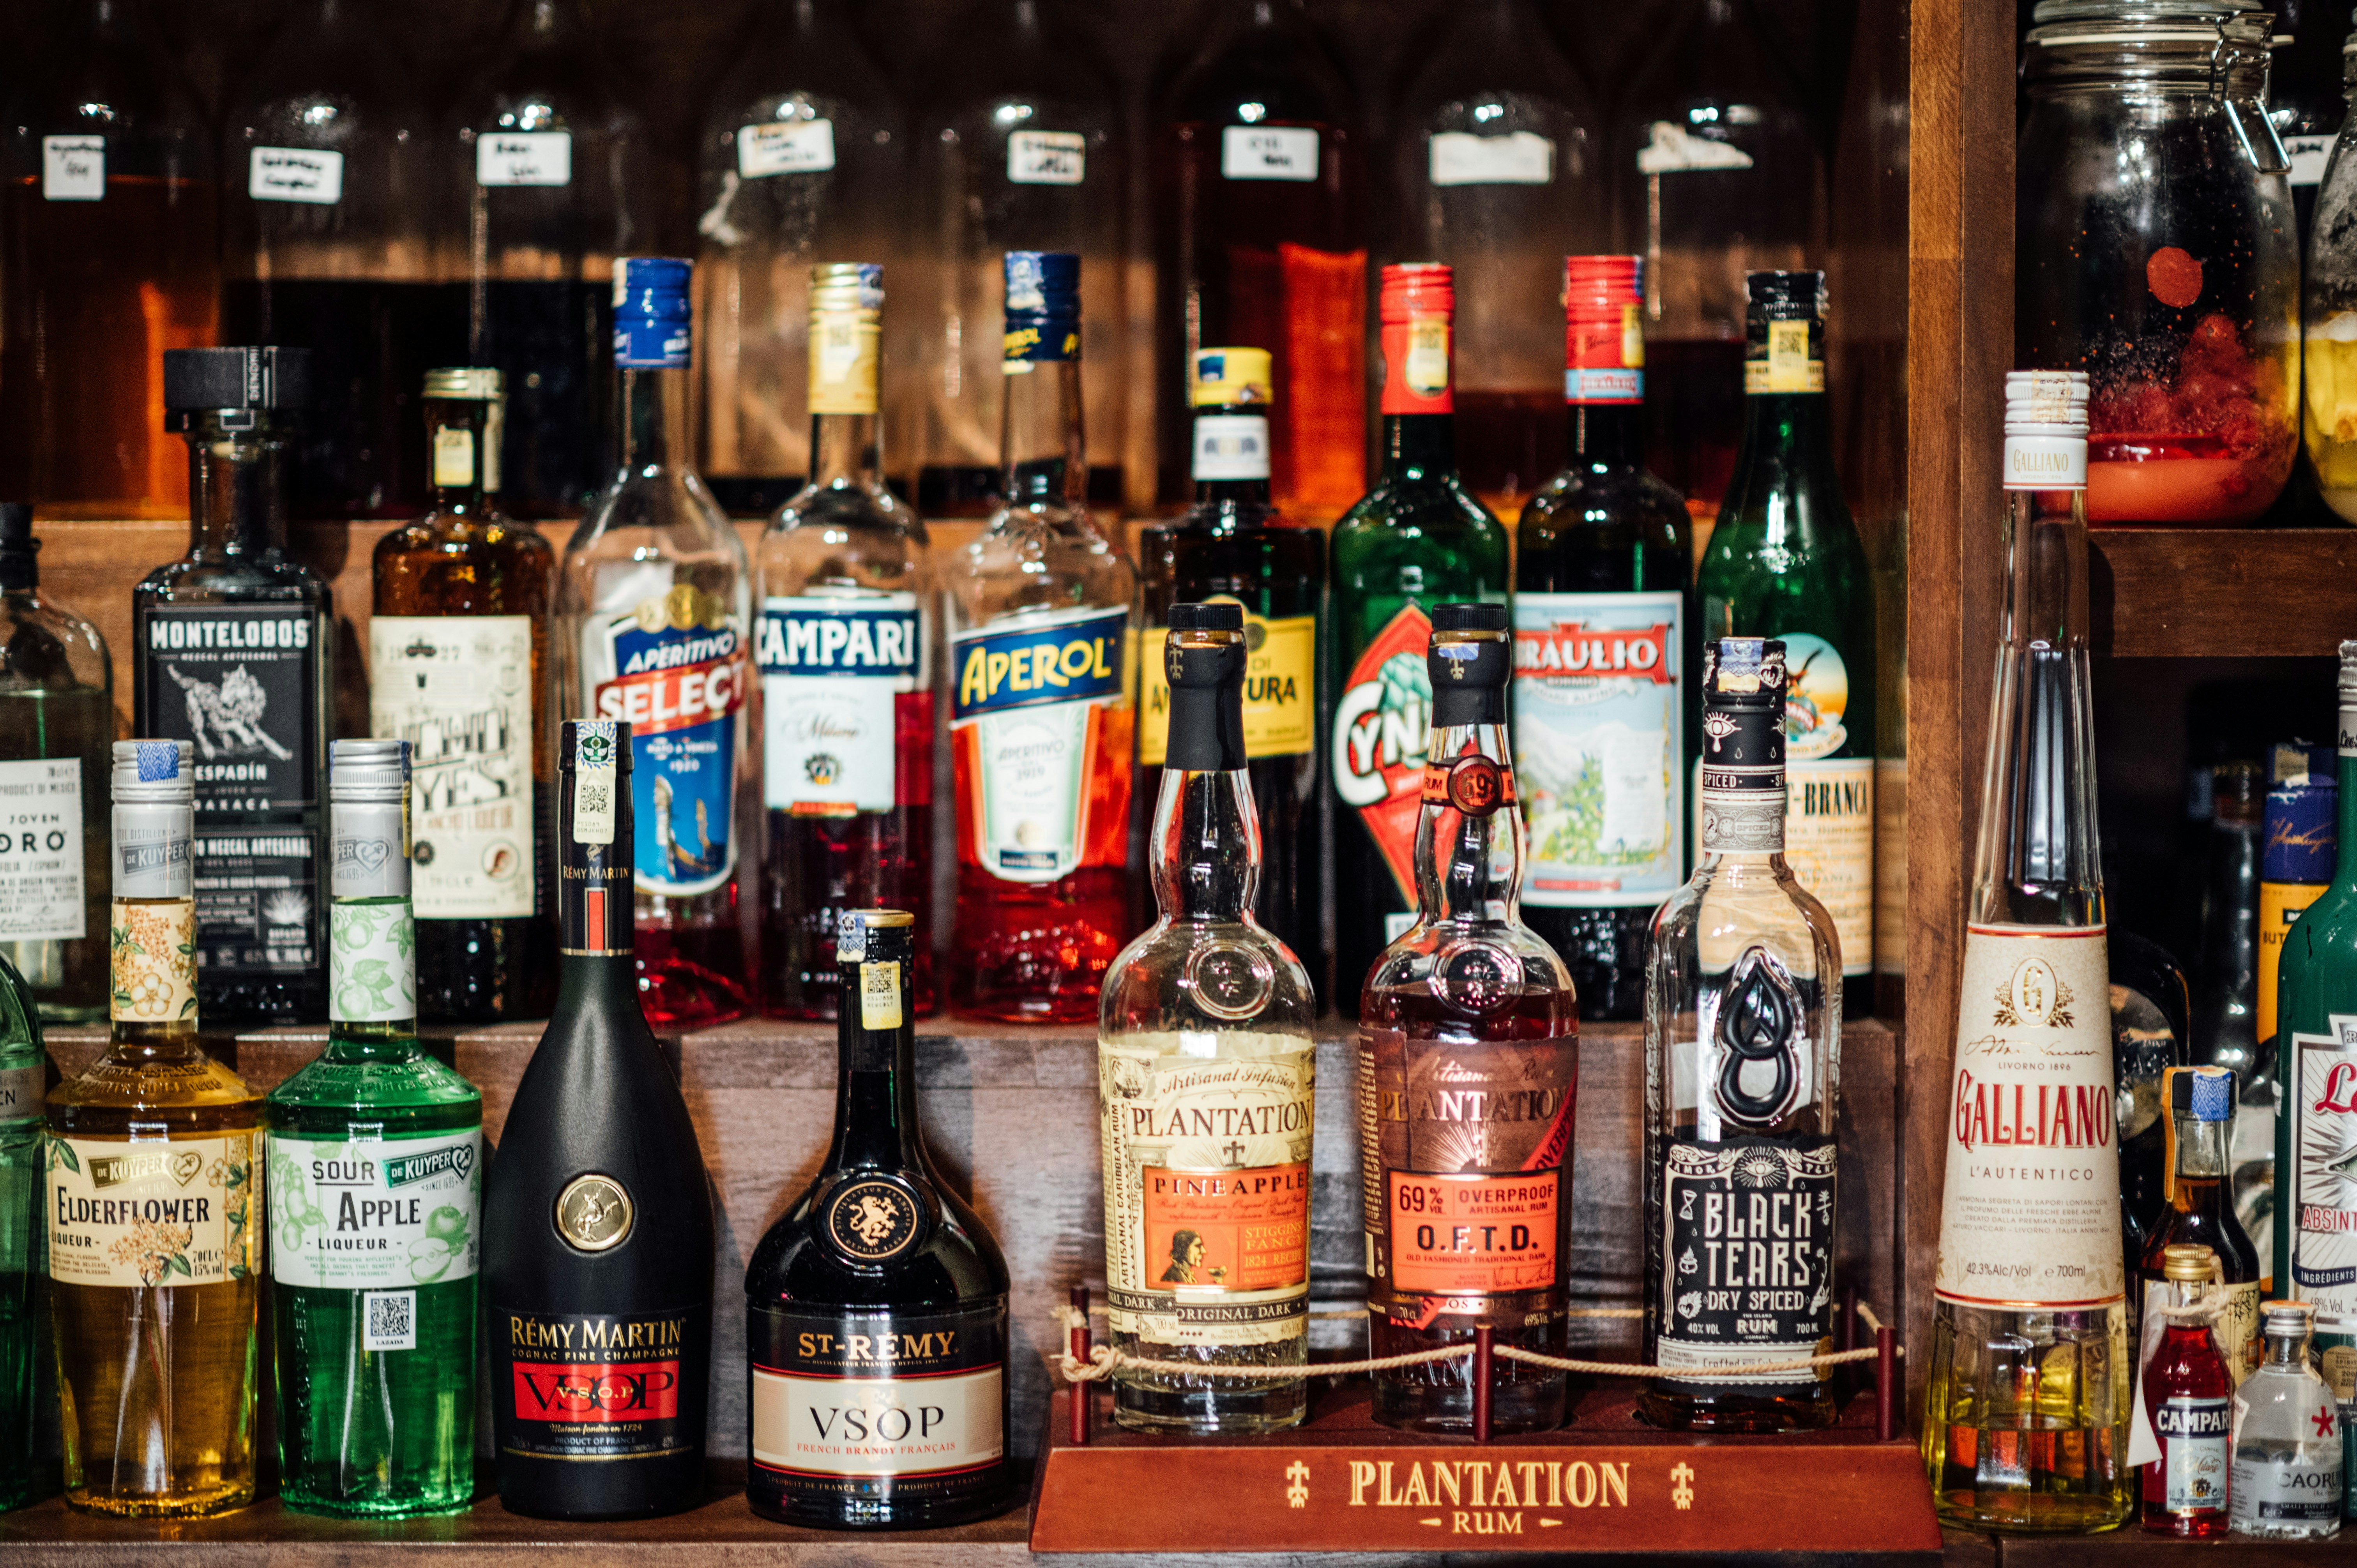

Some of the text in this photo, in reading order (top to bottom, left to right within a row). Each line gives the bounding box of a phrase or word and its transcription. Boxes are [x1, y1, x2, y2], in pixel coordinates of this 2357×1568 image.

[2014, 449, 2068, 473] GALLIANO
[151, 619, 309, 649] MONTELOBOS
[754, 616, 915, 666] CAMPARI
[625, 631, 736, 673] APERITIVO
[961, 637, 1111, 706] APEROL
[599, 662, 745, 726] SELECT
[196, 761, 268, 781] ESPADÍN
[1704, 775, 1737, 788] SPICED
[138, 844, 185, 867] KUYPER
[563, 864, 629, 880] RÉMY MARTIN
[1998, 1062, 2071, 1070] LIVORNO 1896
[1163, 1067, 1296, 1093] Artisanal Infusion
[1131, 1099, 1310, 1137] PLANTATION
[1956, 1069, 2110, 1153] GALLIANO
[110, 1155, 163, 1181] KUYPER
[313, 1160, 375, 1180] SOUR
[391, 1153, 451, 1180] DE KUYPER
[1970, 1166, 2093, 1180] L'AUTENTICO
[426, 1180, 441, 1191] SINCE
[1155, 1171, 1304, 1197] PINEAPPLE
[1459, 1184, 1554, 1204] OVERPROOF
[57, 1185, 210, 1226] ELDERFLOWER
[337, 1191, 421, 1231] APPLE
[1470, 1202, 1548, 1215] ARTISANAL RUM
[1704, 1192, 1812, 1239] BLACK
[318, 1238, 387, 1250] LIQUEUR
[1118, 1213, 1130, 1286] ARTISANAL
[1417, 1224, 1538, 1254] O.F.T.D.
[1705, 1241, 1811, 1286] TEARS
[2057, 1265, 2086, 1278] 700ml
[2300, 1270, 2355, 1284] INGRÉDIENTS
[1125, 1297, 1155, 1310] DARK
[1176, 1303, 1291, 1320] ORIGINAL DARK
[1708, 1291, 1804, 1310] DRY SPICED
[511, 1316, 681, 1349] RÉMY MARTIN
[1706, 1324, 1720, 1335] VOL
[1737, 1319, 1778, 1334] RUM
[512, 1347, 680, 1361] COGNAC FINE CHAMPAGNE
[799, 1331, 955, 1361] ST-RÉMY
[809, 1406, 944, 1441] VSOP
[797, 1441, 956, 1456] FRENCH BRANDY FRANÇAIS
[1349, 1461, 1630, 1508] PLANTATION
[1452, 1511, 1523, 1534] RUM
